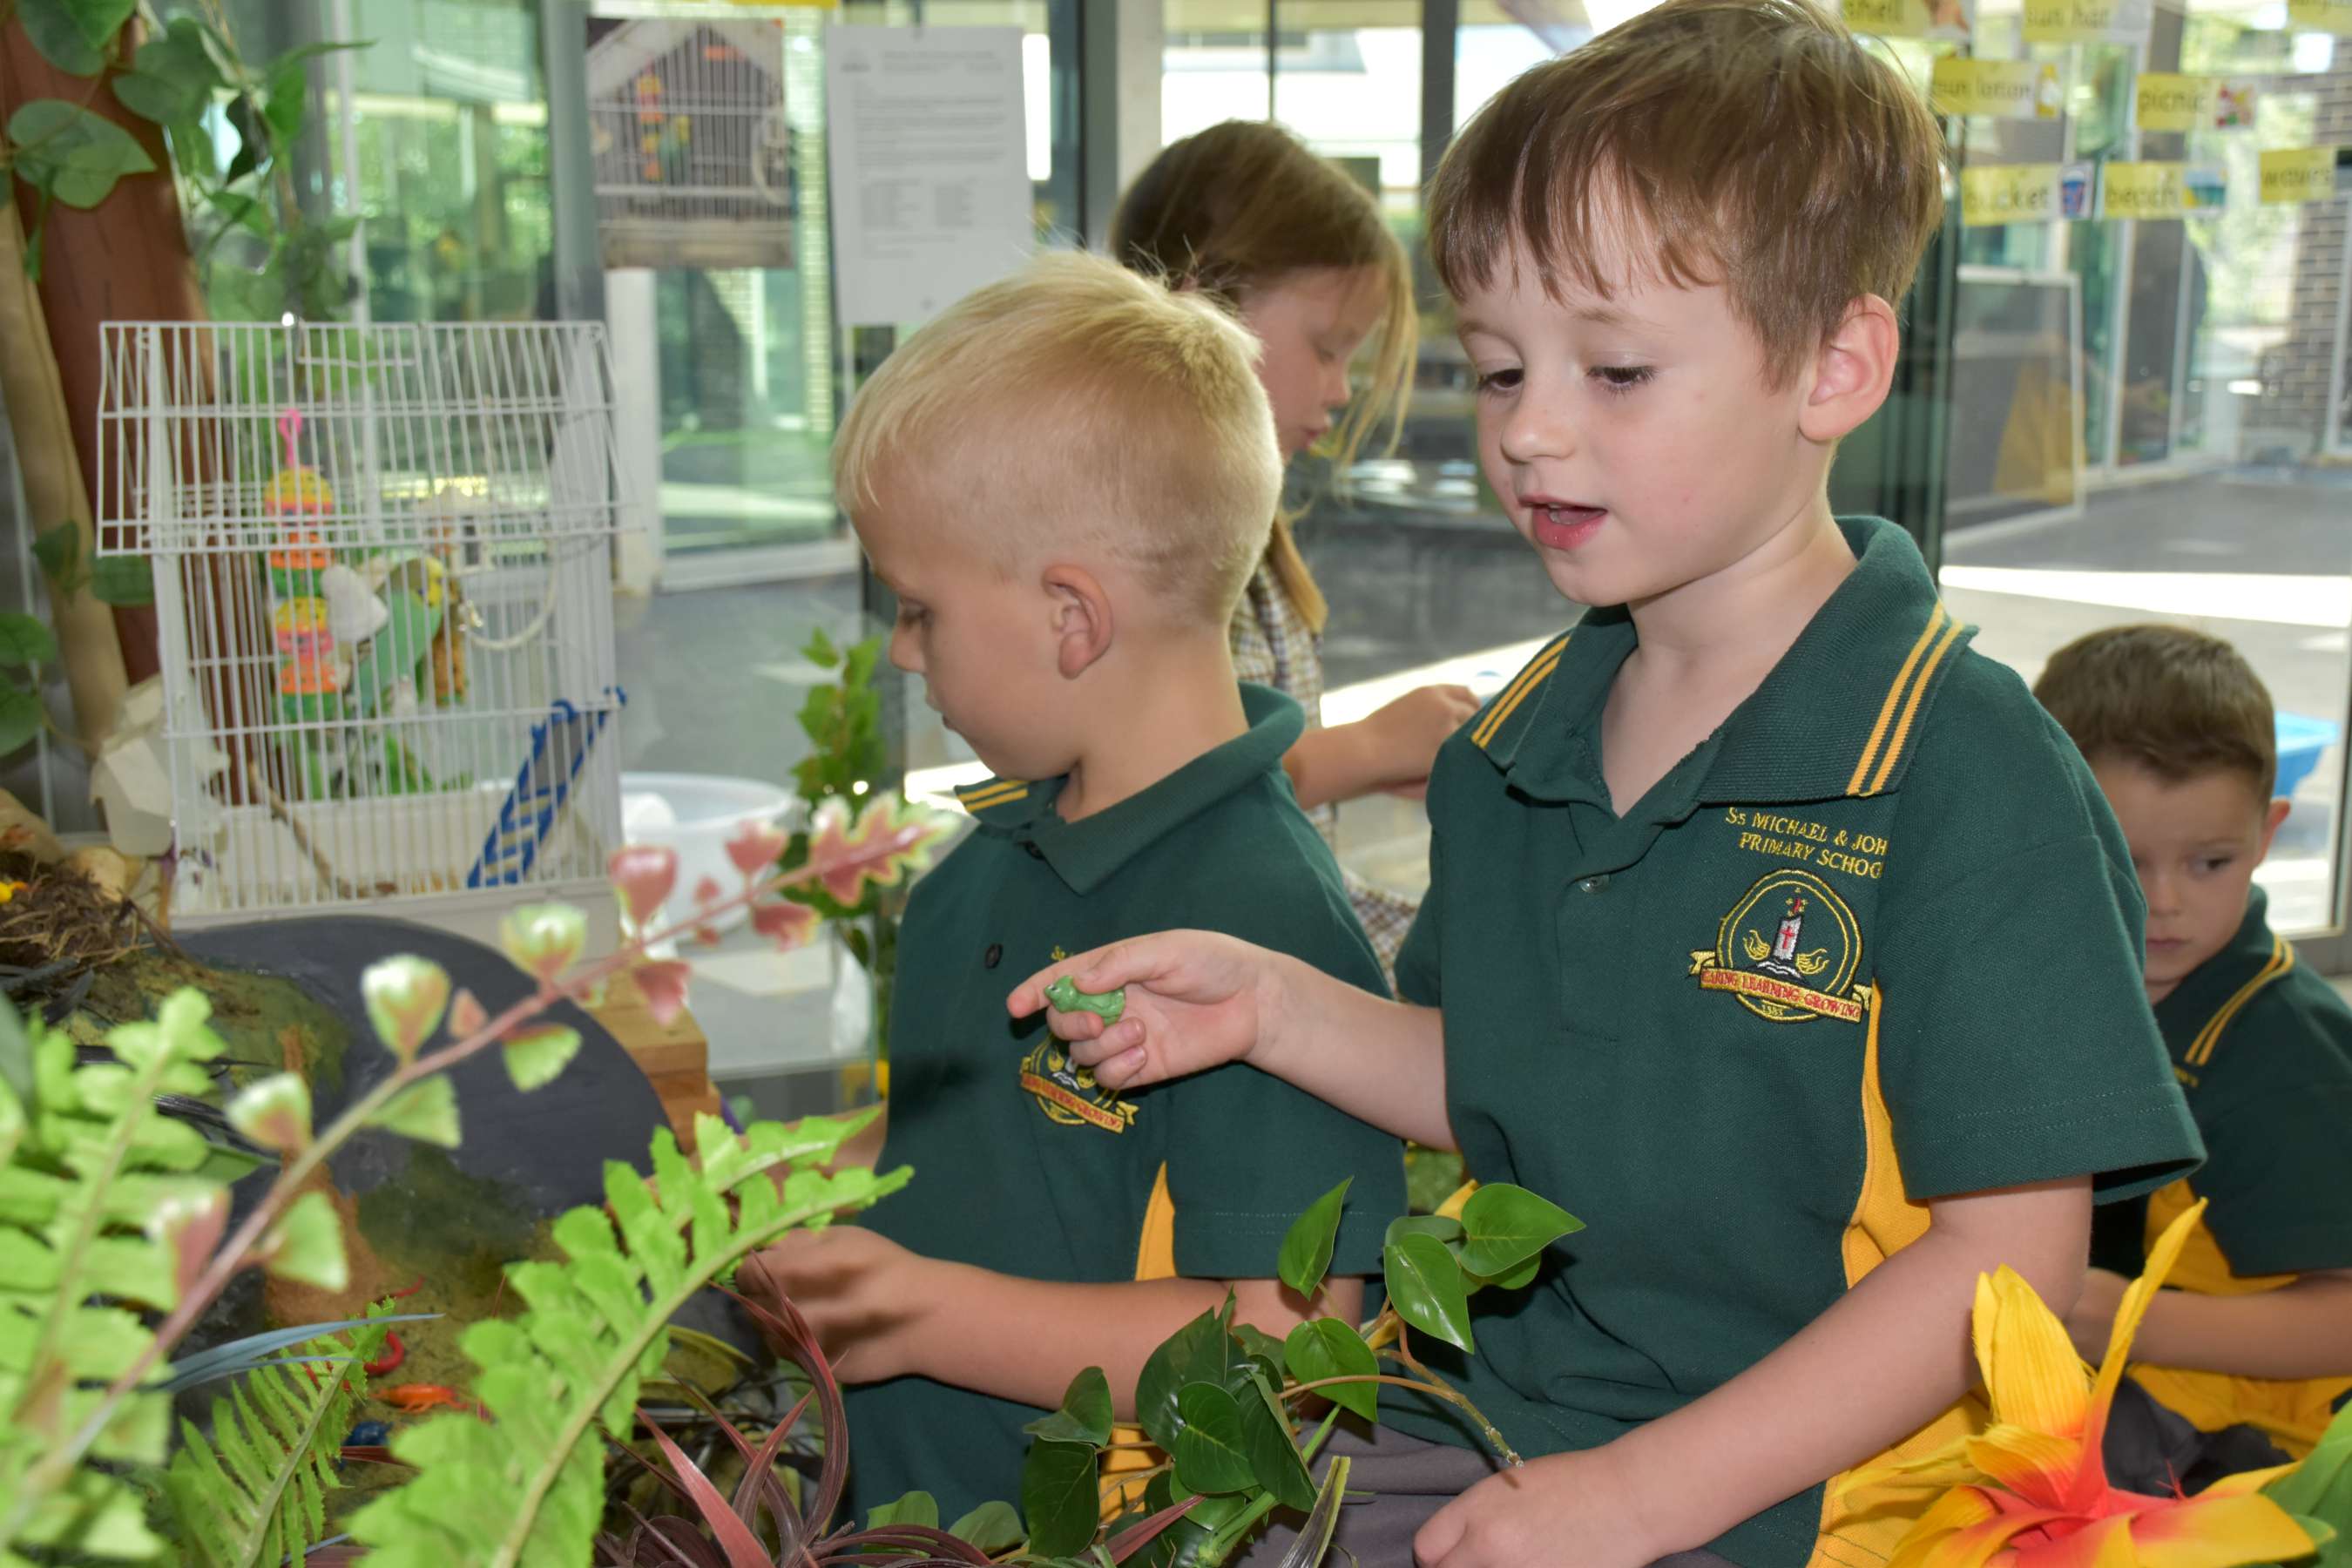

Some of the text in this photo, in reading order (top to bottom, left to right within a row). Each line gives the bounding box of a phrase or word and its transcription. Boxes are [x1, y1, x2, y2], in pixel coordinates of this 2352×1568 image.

[1738, 832, 1815, 861] PRIMARY
[1752, 812, 1828, 842] MICHAEL
[1834, 829, 1848, 848] &
[1742, 975, 1801, 1001] LEARNING
[1804, 994, 1862, 1017] GROWING
